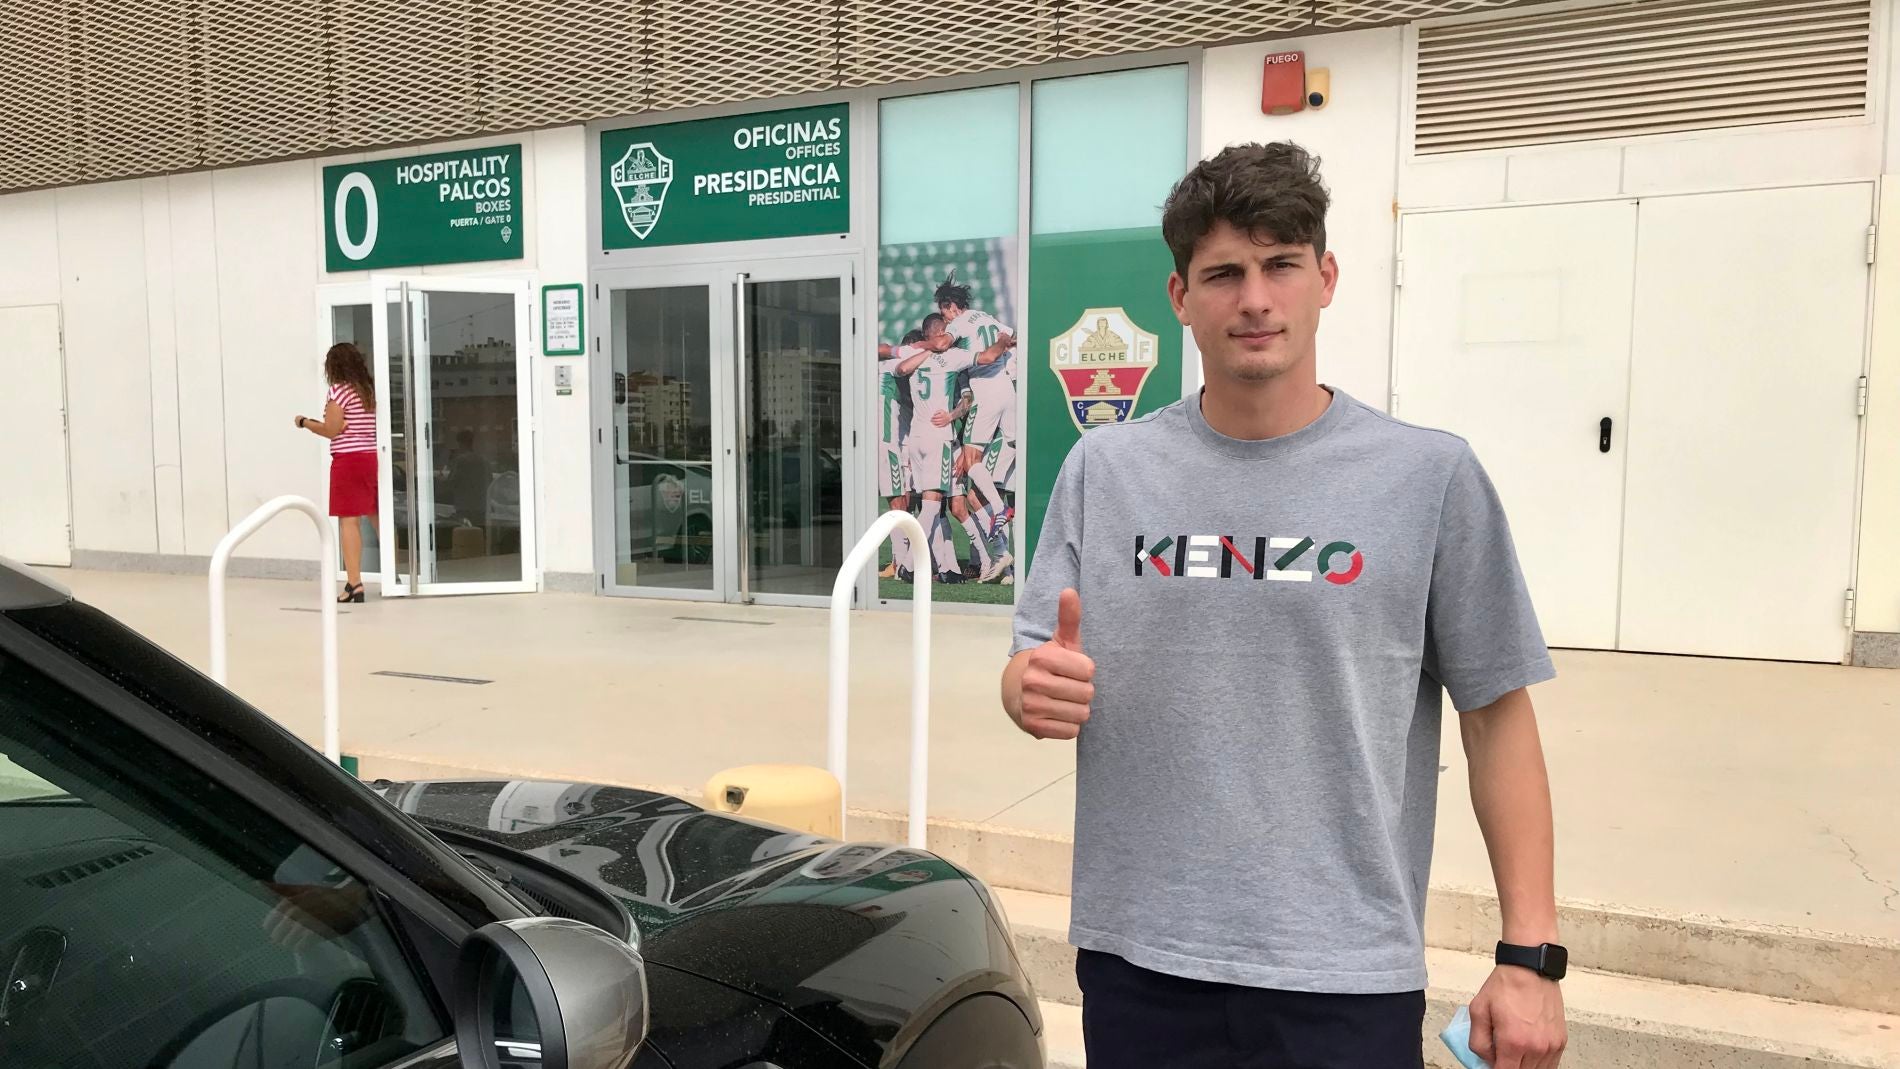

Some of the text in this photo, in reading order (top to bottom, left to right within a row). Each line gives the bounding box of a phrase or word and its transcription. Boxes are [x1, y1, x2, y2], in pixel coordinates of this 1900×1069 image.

[1266, 53, 1299, 65] FUEGO
[733, 117, 841, 150] OFICINAS
[785, 141, 841, 160] OFFICES
[396, 154, 510, 185] HOSPITALITY
[615, 164, 669, 181] C ELCHE F
[694, 162, 841, 195] PRESIDENCIA
[439, 177, 511, 202] PALCOS
[748, 187, 841, 207] PRESIDENTIAL
[335, 171, 379, 261] 0
[475, 200, 511, 213] BOXES
[450, 217, 479, 227] PUERTA
[484, 215, 505, 225] GATE
[1056, 341, 1150, 362] C ELCHE F
[918, 367, 931, 400] 5
[1077, 402, 1084, 410] C
[1118, 408, 1125, 416] A
[1134, 535, 1364, 585] KENZO
